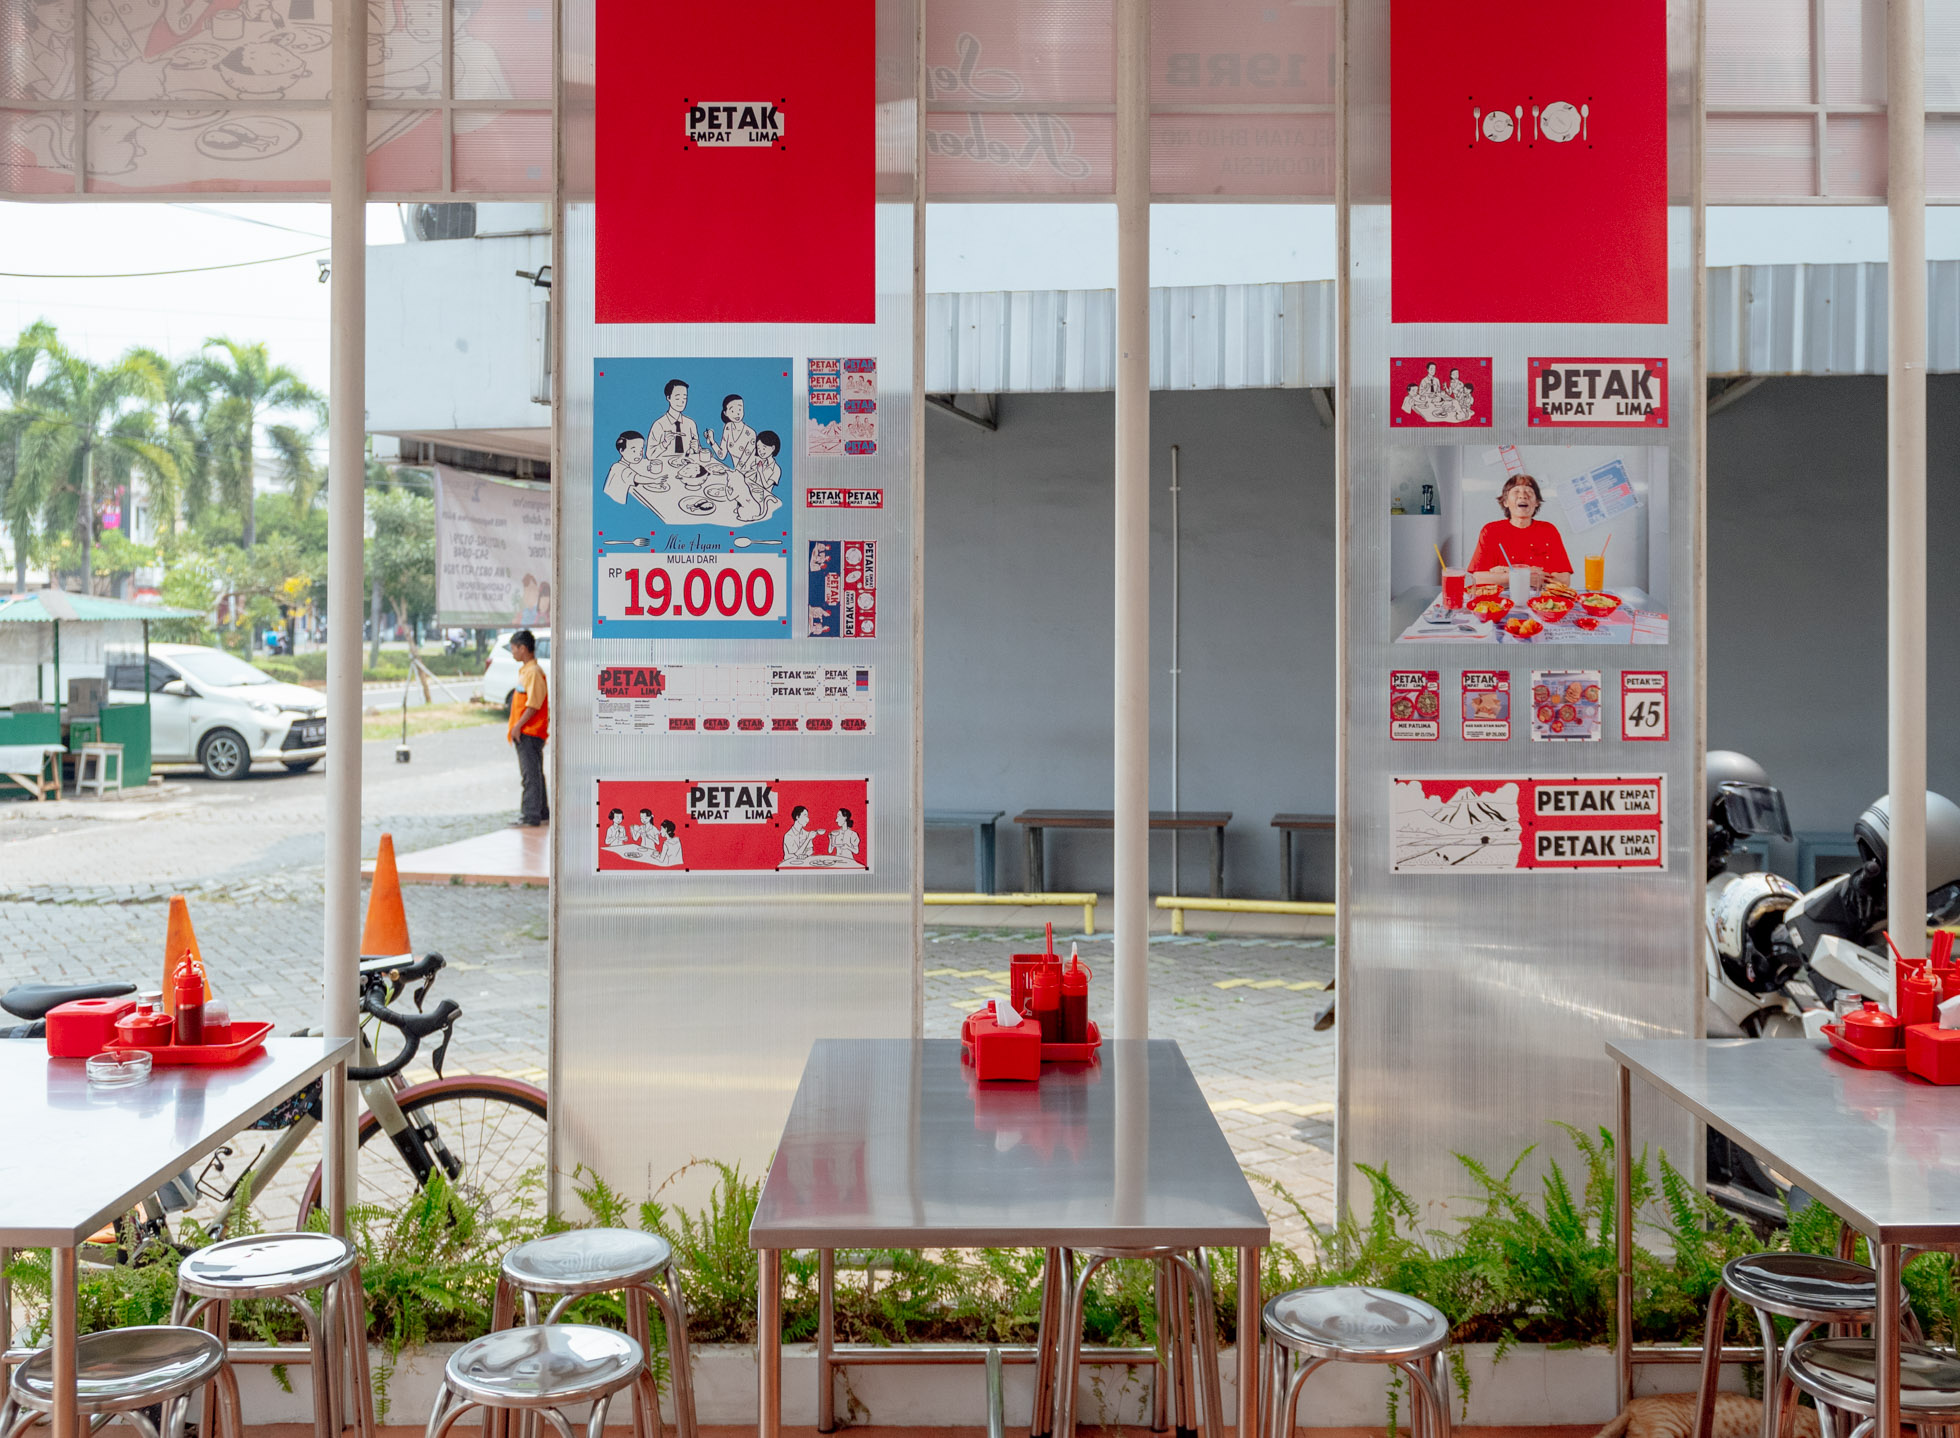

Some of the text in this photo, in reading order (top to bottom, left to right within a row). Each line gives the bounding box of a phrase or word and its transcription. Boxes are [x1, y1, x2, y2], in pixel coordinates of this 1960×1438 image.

[690, 106, 778, 129] PETAK
[690, 132, 779, 142] EMPAT LIMA
[1541, 369, 1653, 399] PETAK
[1542, 402, 1654, 416] EMPAT LIMA
[810, 492, 879, 500] PETAK PETAK
[664, 534, 720, 552] Mie Ayam
[667, 555, 717, 563] MULAI DARI
[865, 543, 873, 573] PETAK
[608, 567, 775, 617] RP 19.000
[601, 670, 661, 686] PETAK
[772, 671, 801, 679] PETAK
[1394, 675, 1423, 683] PETAK
[1465, 675, 1494, 683] PETAK
[772, 688, 801, 696] PETAK
[1629, 701, 1661, 727] 45
[690, 787, 772, 808] PETAK
[1620, 790, 1655, 799] EMPAT
[1538, 790, 1615, 811] PETAK
[1624, 802, 1651, 810] LIMA
[690, 810, 773, 820] EMPAT LIMA
[1621, 835, 1655, 844] EMPAT
[1538, 835, 1615, 856] PETAK
[1625, 847, 1651, 856] LIMA
